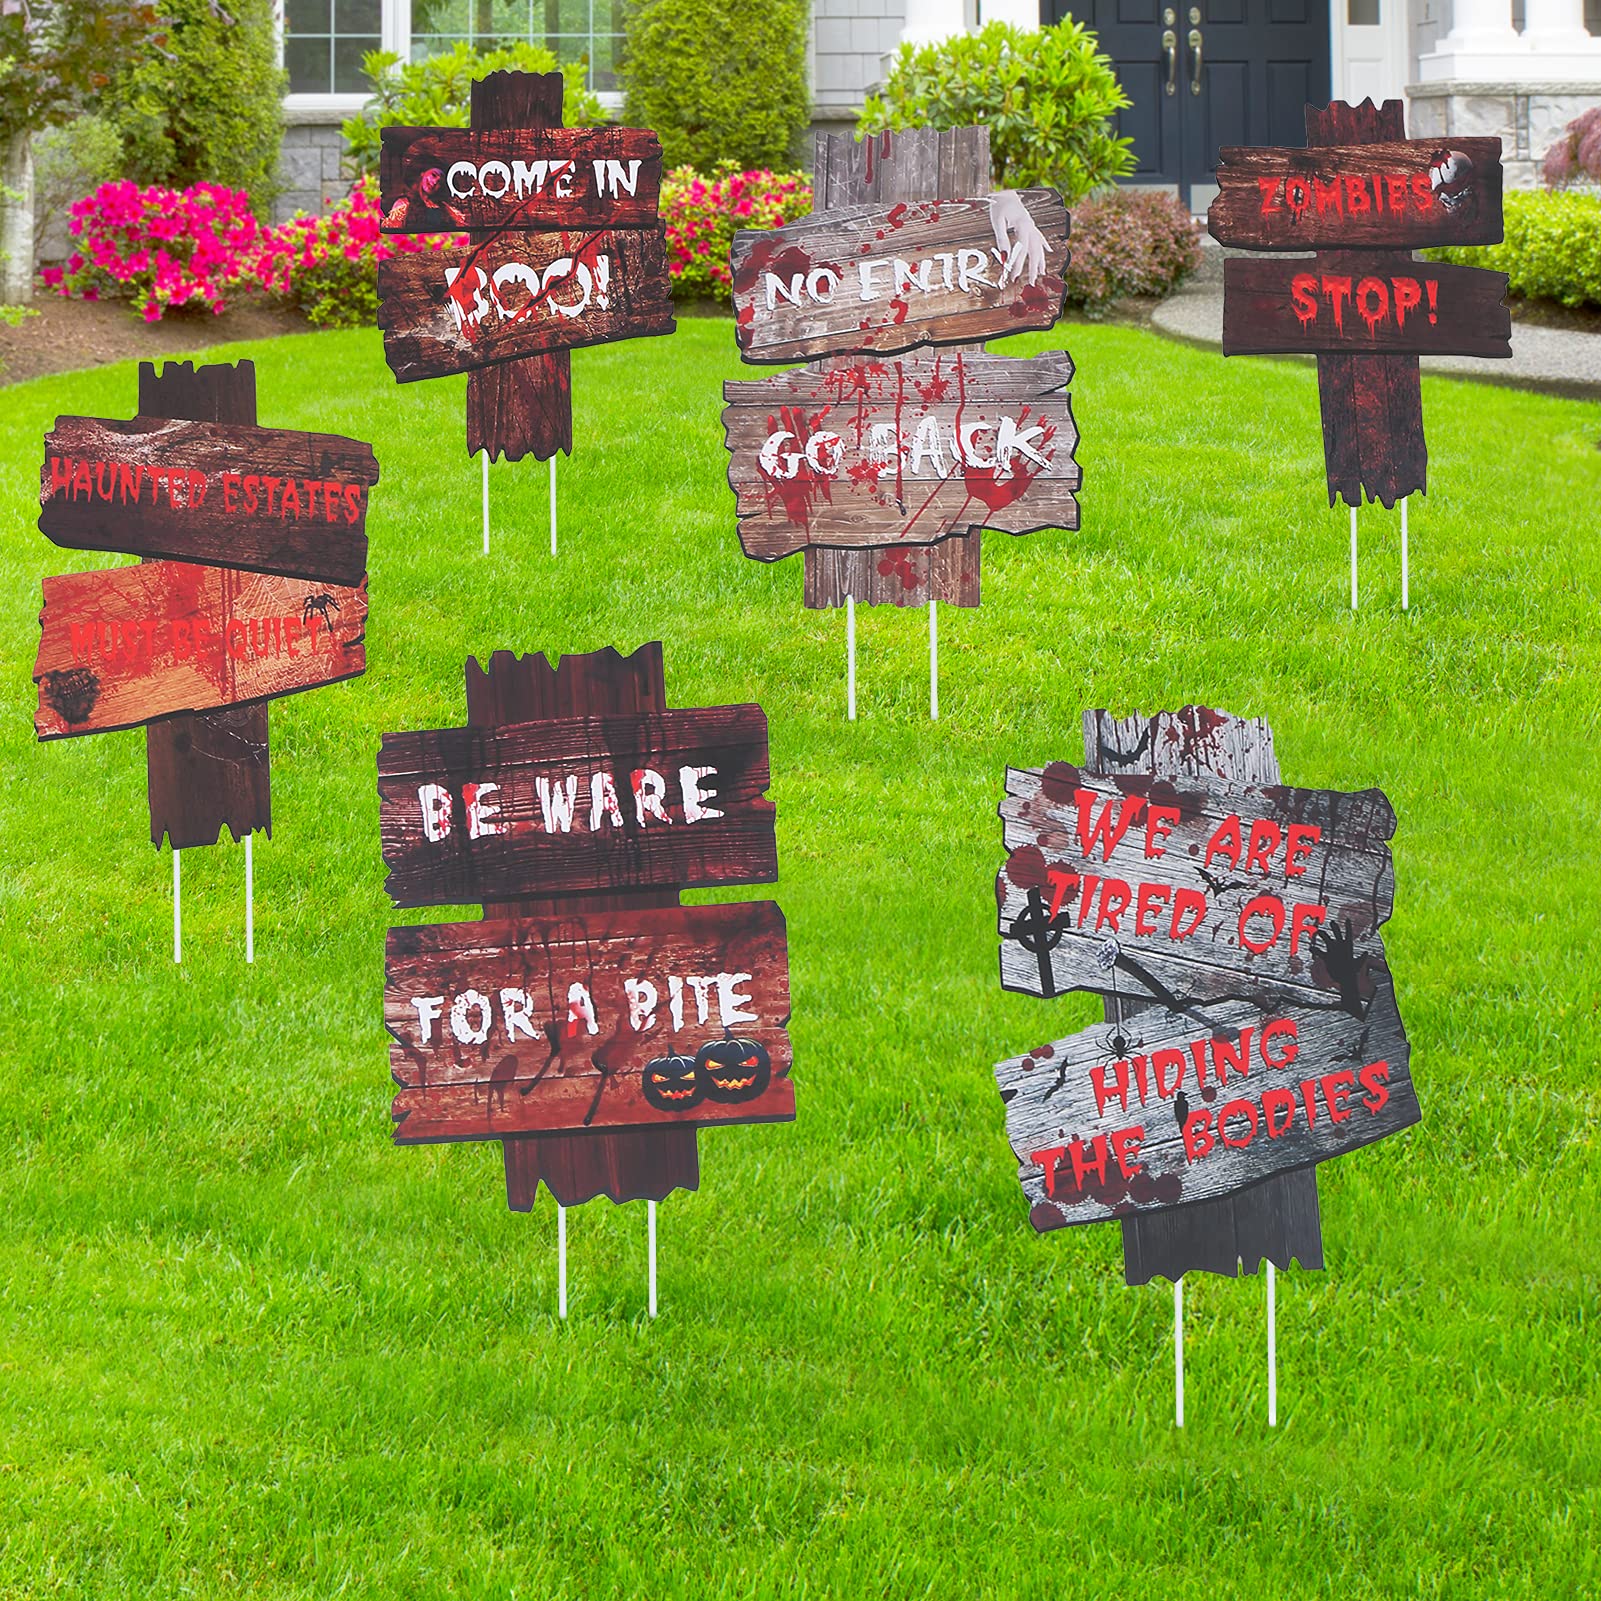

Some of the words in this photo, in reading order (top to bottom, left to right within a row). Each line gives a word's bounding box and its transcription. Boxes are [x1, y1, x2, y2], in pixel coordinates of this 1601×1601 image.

[447, 160, 576, 200] COME
[593, 159, 642, 200] IN
[1258, 172, 1434, 226] ZOMBIES
[444, 255, 610, 332] BOO!
[765, 268, 839, 310] NO
[858, 241, 1024, 302] ENTRY
[1291, 273, 1439, 341] STOP!
[759, 430, 844, 479] GO
[869, 416, 1053, 479] BACK
[50, 456, 207, 510] HAUNTED
[222, 473, 361, 525] ESTATES
[70, 618, 160, 664] MUST
[172, 618, 210, 658] BE
[225, 616, 324, 661] QUIET
[417, 782, 507, 843] BE
[535, 765, 725, 834] WARE
[1074, 789, 1181, 863] WE
[1203, 813, 1322, 877] ARE
[1045, 870, 1207, 944] TIRED
[1238, 895, 1327, 957] OF
[410, 987, 541, 1045] FOR
[566, 981, 599, 1038] A
[624, 971, 759, 1033] BITE
[1089, 1018, 1300, 1118] HIDING
[1031, 1125, 1146, 1199] THE
[1180, 1060, 1390, 1166] BODIES
